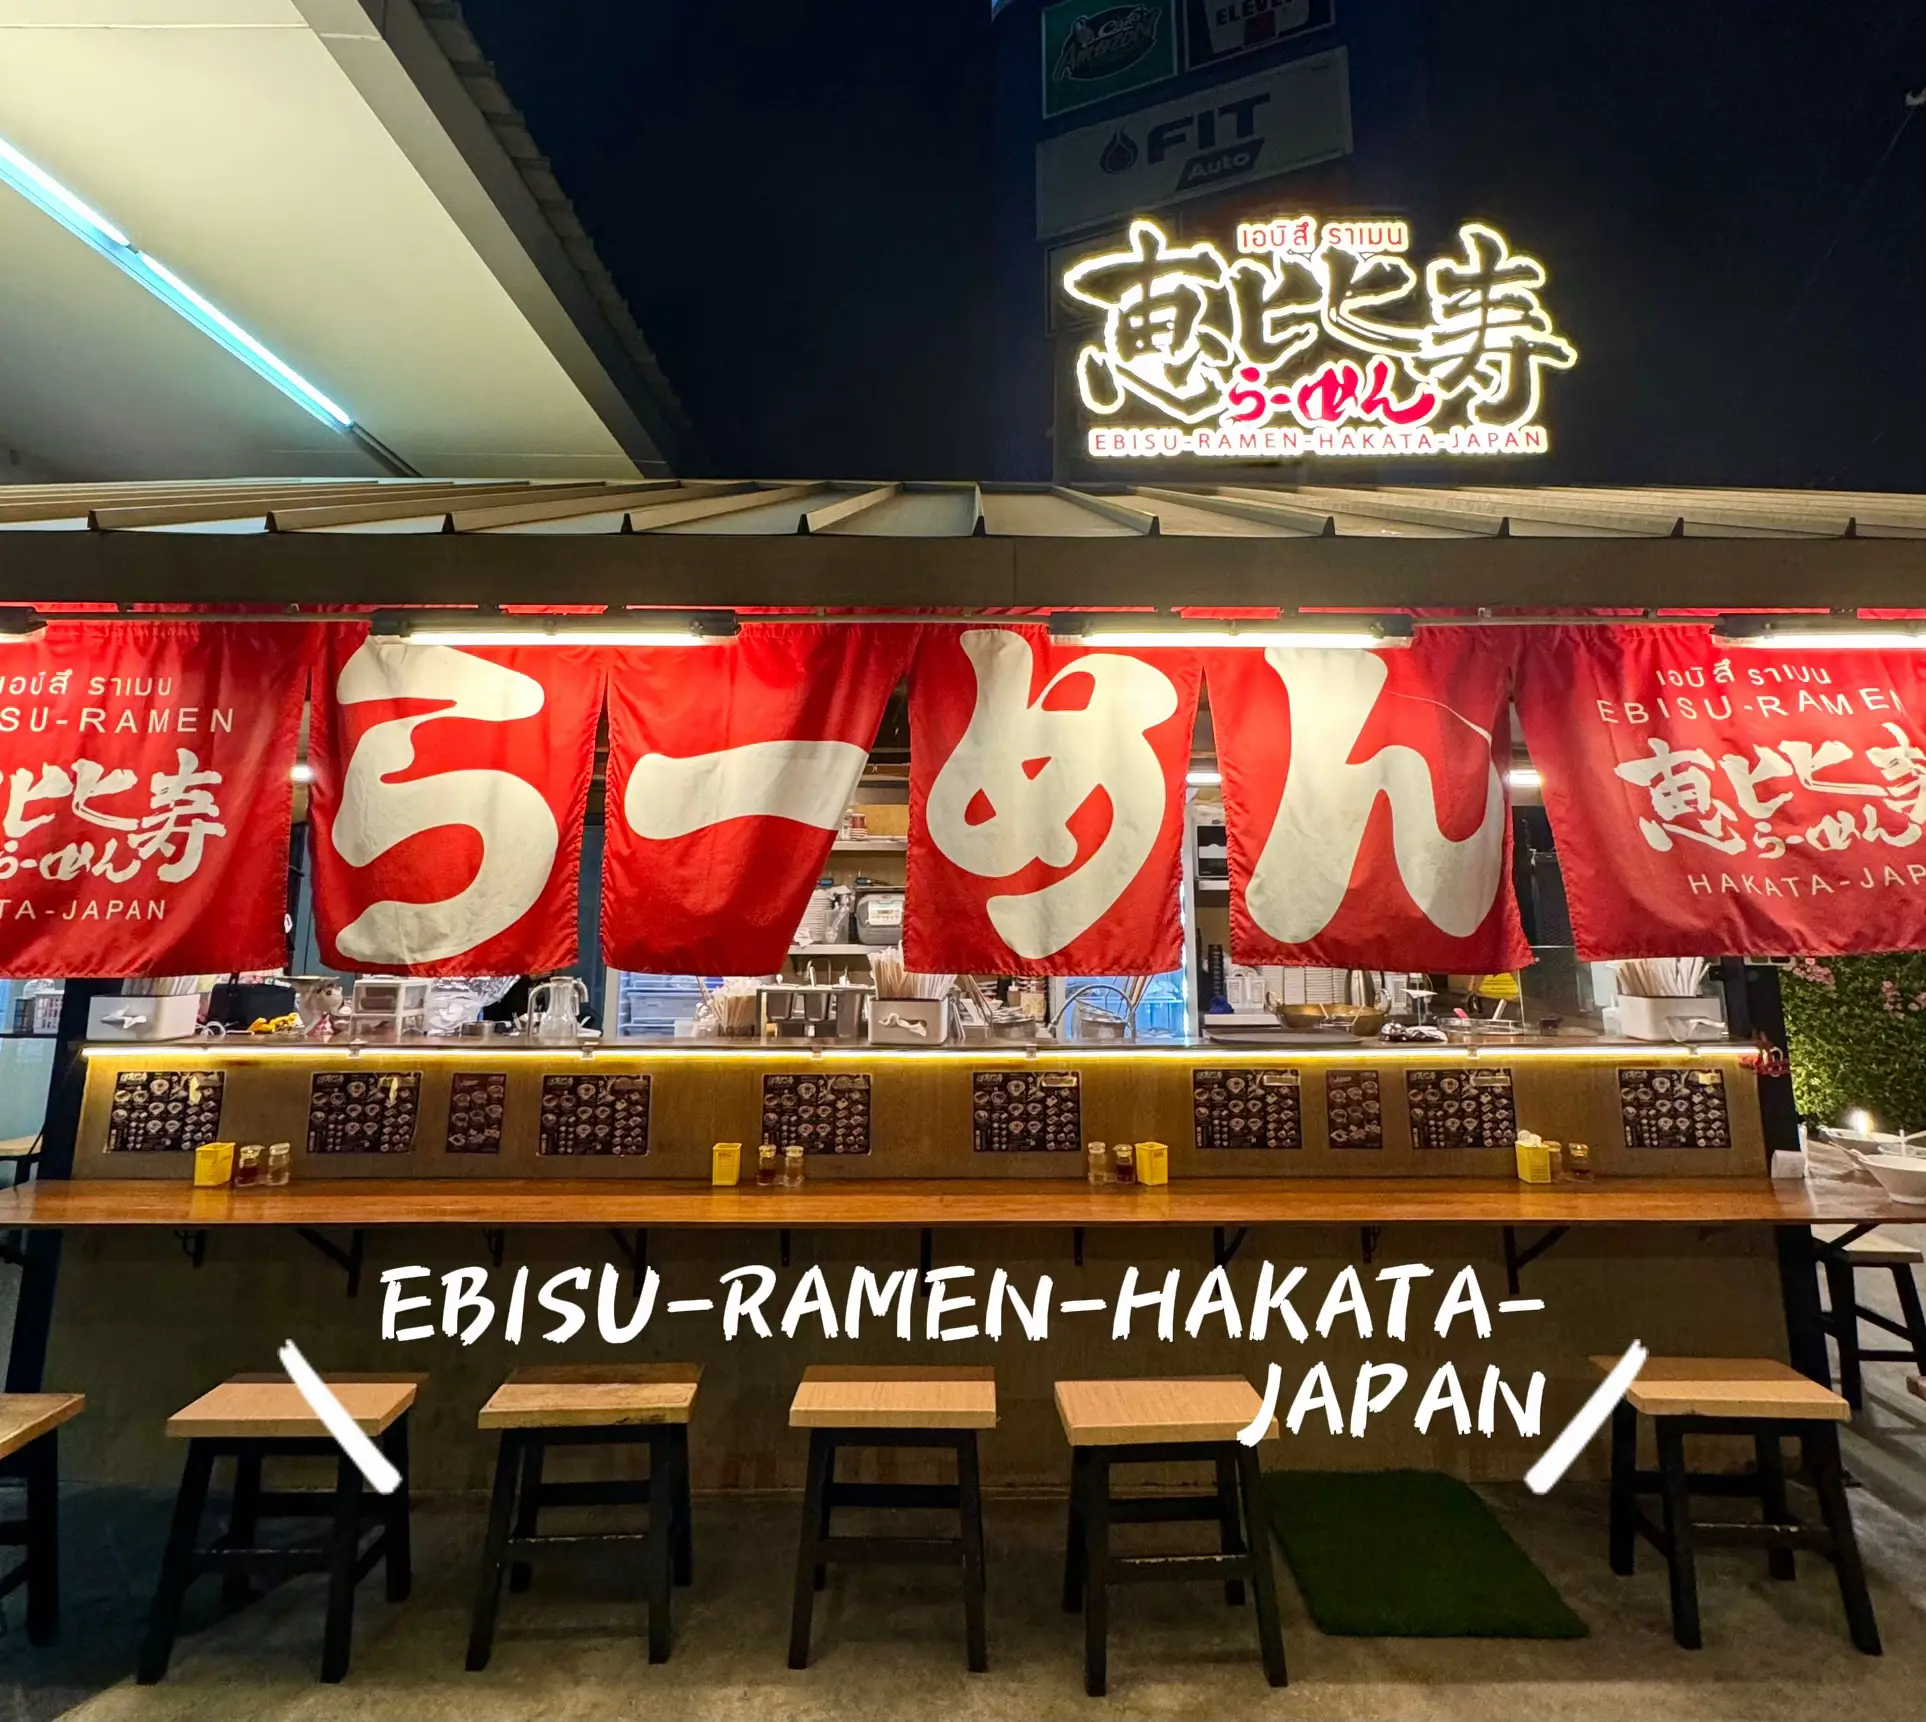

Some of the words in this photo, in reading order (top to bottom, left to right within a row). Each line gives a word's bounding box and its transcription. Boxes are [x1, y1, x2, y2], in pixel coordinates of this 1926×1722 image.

[1215, 0, 1296, 26] ELEV
[1147, 93, 1270, 164] FIT
[1187, 150, 1251, 181] Auto
[1328, 226, 1403, 246] ราเมน
[1094, 430, 1541, 451] EBISU-RAMEN-HAKATA-JAPAN
[88, 676, 172, 696] ราเมน
[0, 748, 226, 883] 比寿
